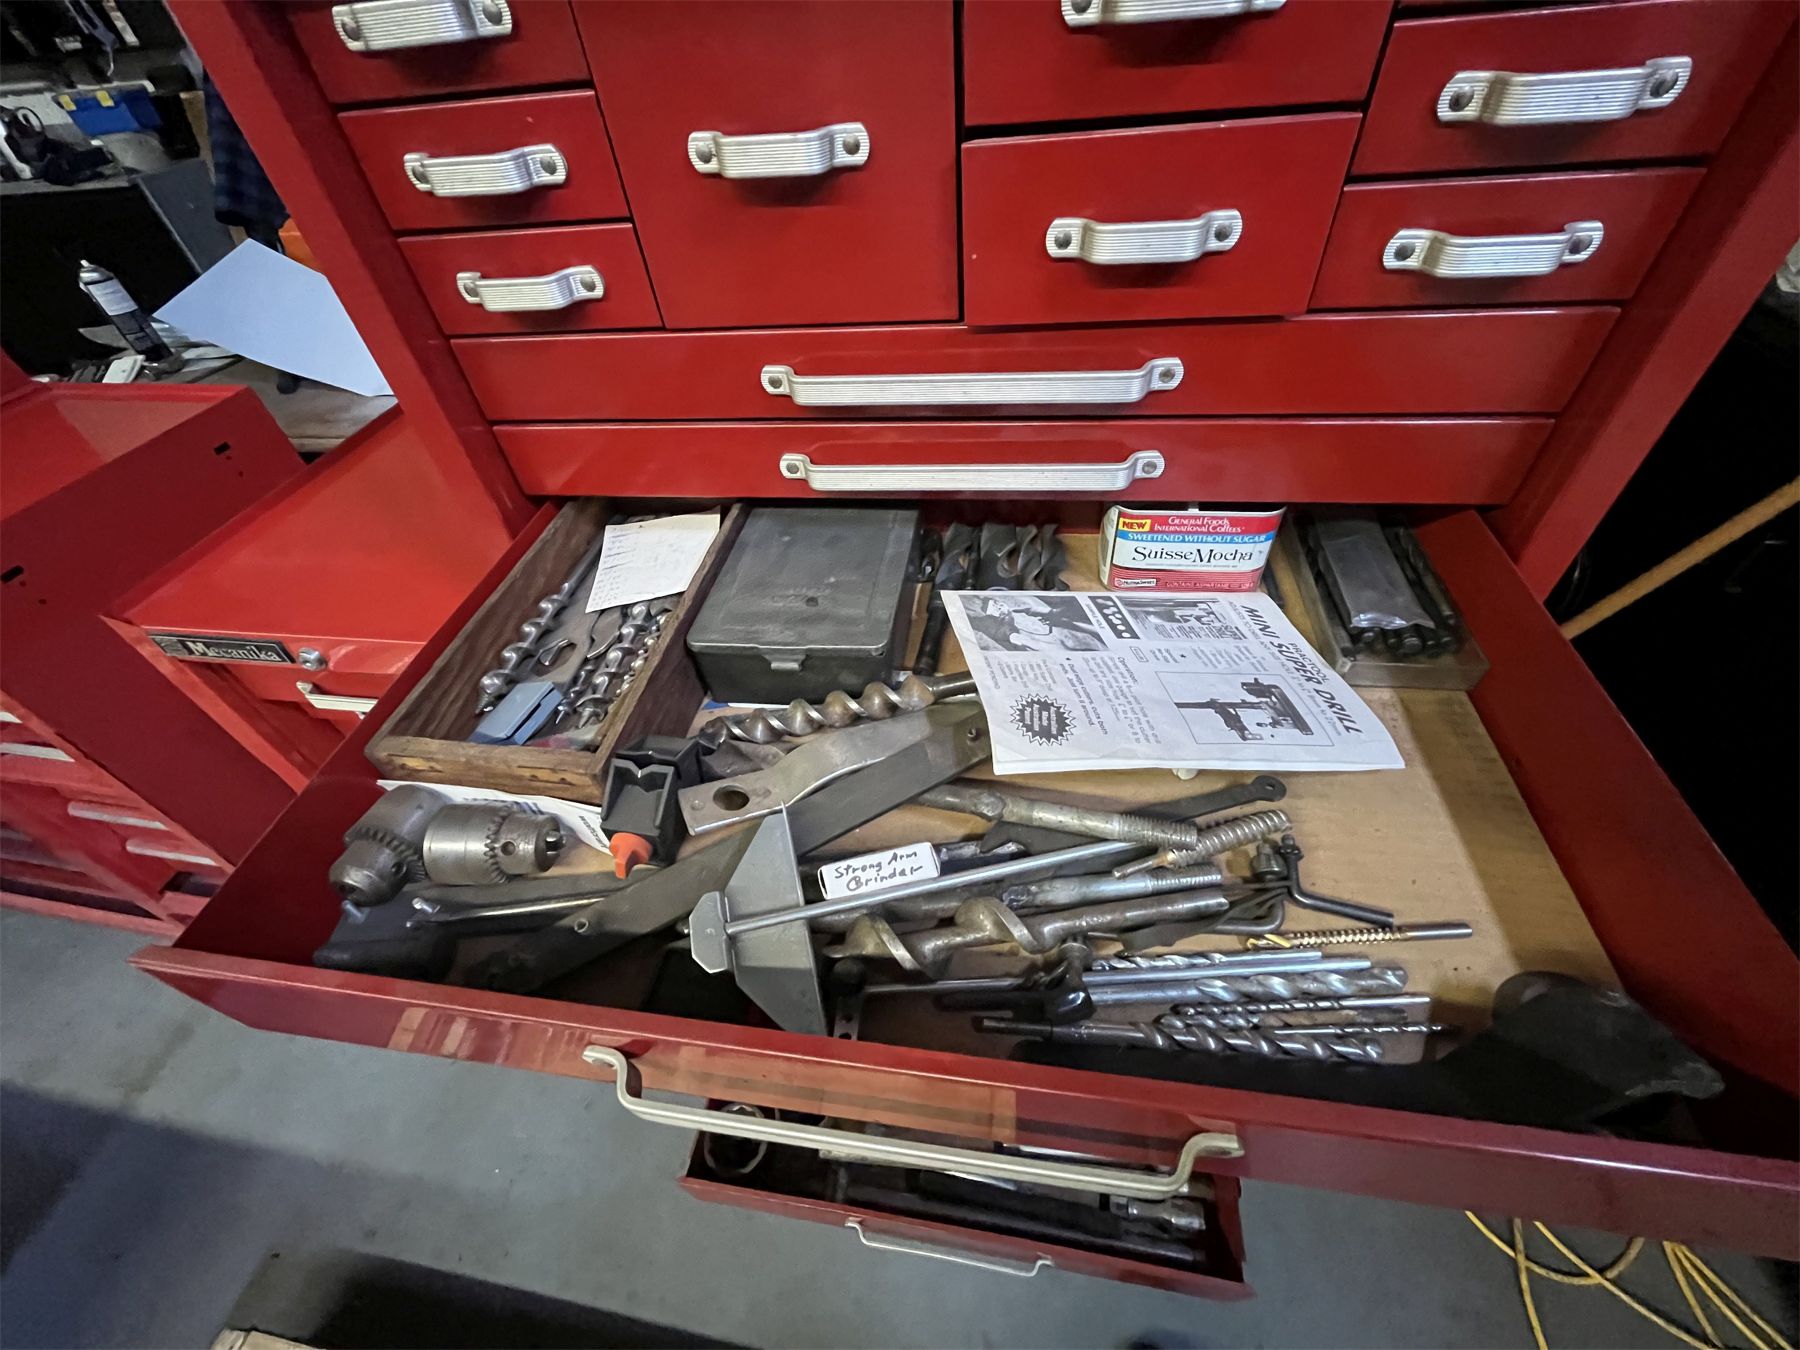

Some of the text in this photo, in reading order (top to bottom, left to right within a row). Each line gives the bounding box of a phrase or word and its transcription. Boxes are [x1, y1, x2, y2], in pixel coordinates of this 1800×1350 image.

[1122, 520, 1148, 530] NEW
[1128, 533, 1267, 543] SWEETENED WITHOUT SUGAR
[1132, 545, 1253, 564] Suisse Mocha
[184, 641, 283, 662] Mecanika
[1288, 642, 1330, 682] PRACTOOL
[1240, 605, 1280, 639] MINI
[1270, 641, 1323, 686] SUPER
[1313, 687, 1364, 734] DRILL
[834, 851, 918, 879] Strong Arm
